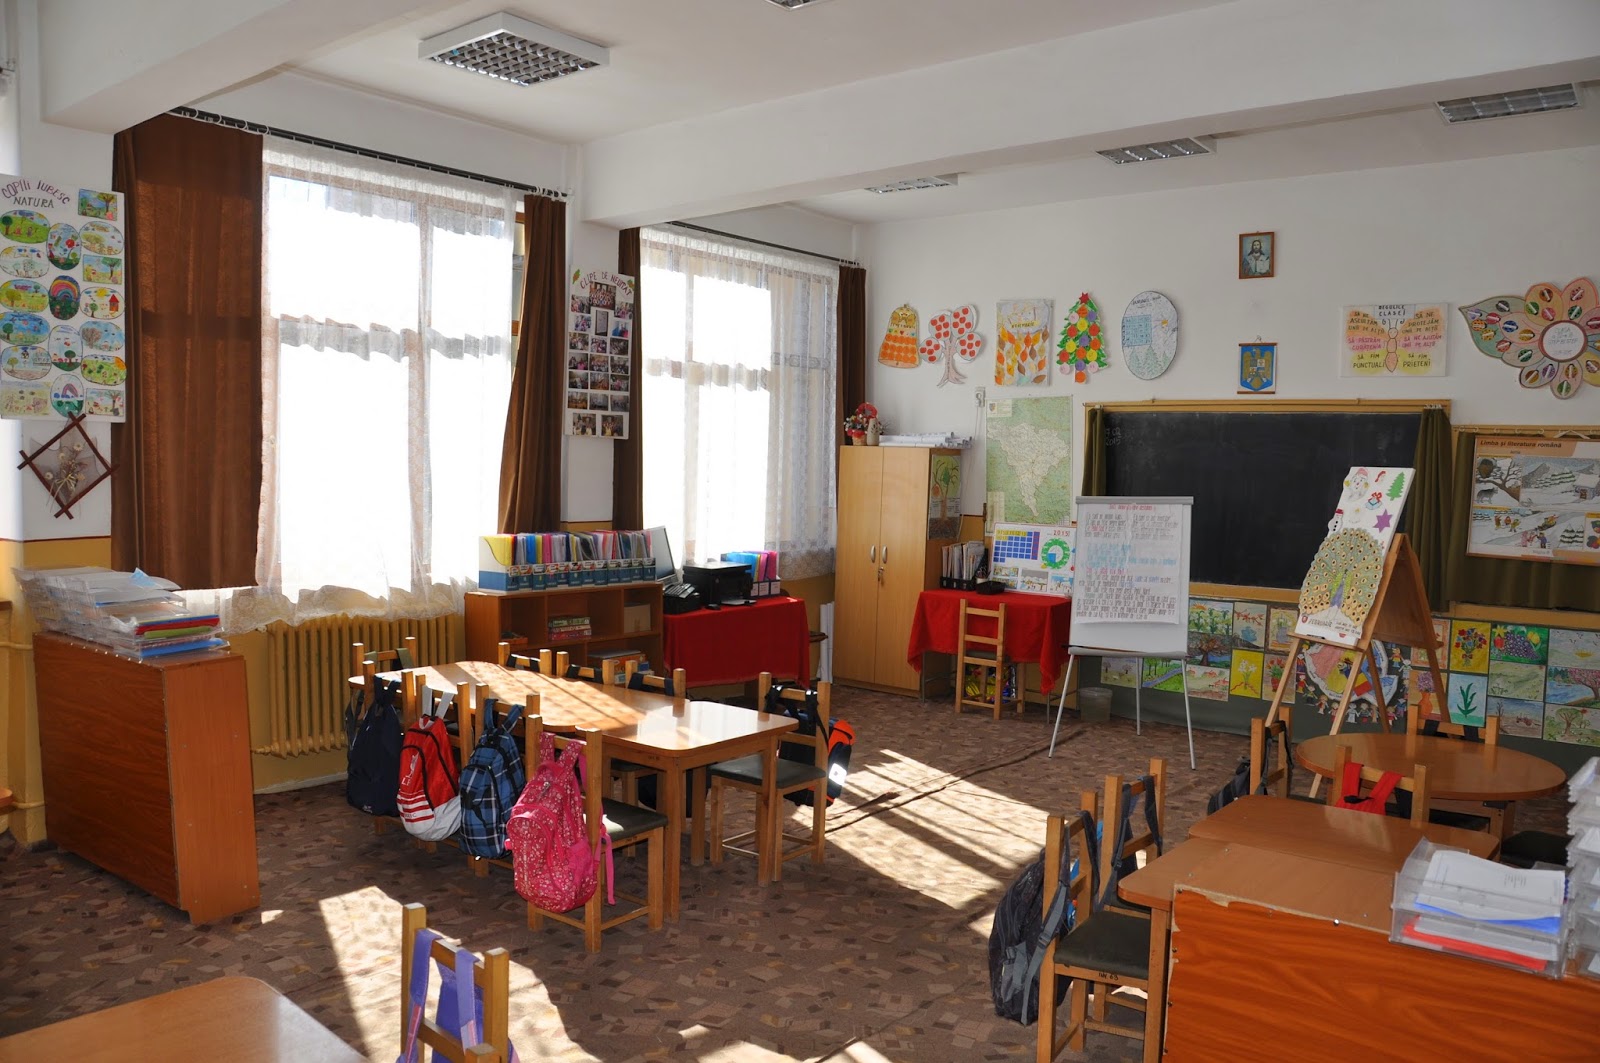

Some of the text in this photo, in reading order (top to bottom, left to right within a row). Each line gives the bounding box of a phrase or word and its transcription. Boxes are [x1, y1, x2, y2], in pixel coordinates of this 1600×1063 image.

[36, 179, 71, 205] IUBESC
[13, 196, 55, 209] NATURA
[580, 271, 597, 289] CLIPE
[601, 271, 608, 280] DE
[1403, 359, 1431, 367] PRIETENI
[1053, 529, 1069, 537] 2015
